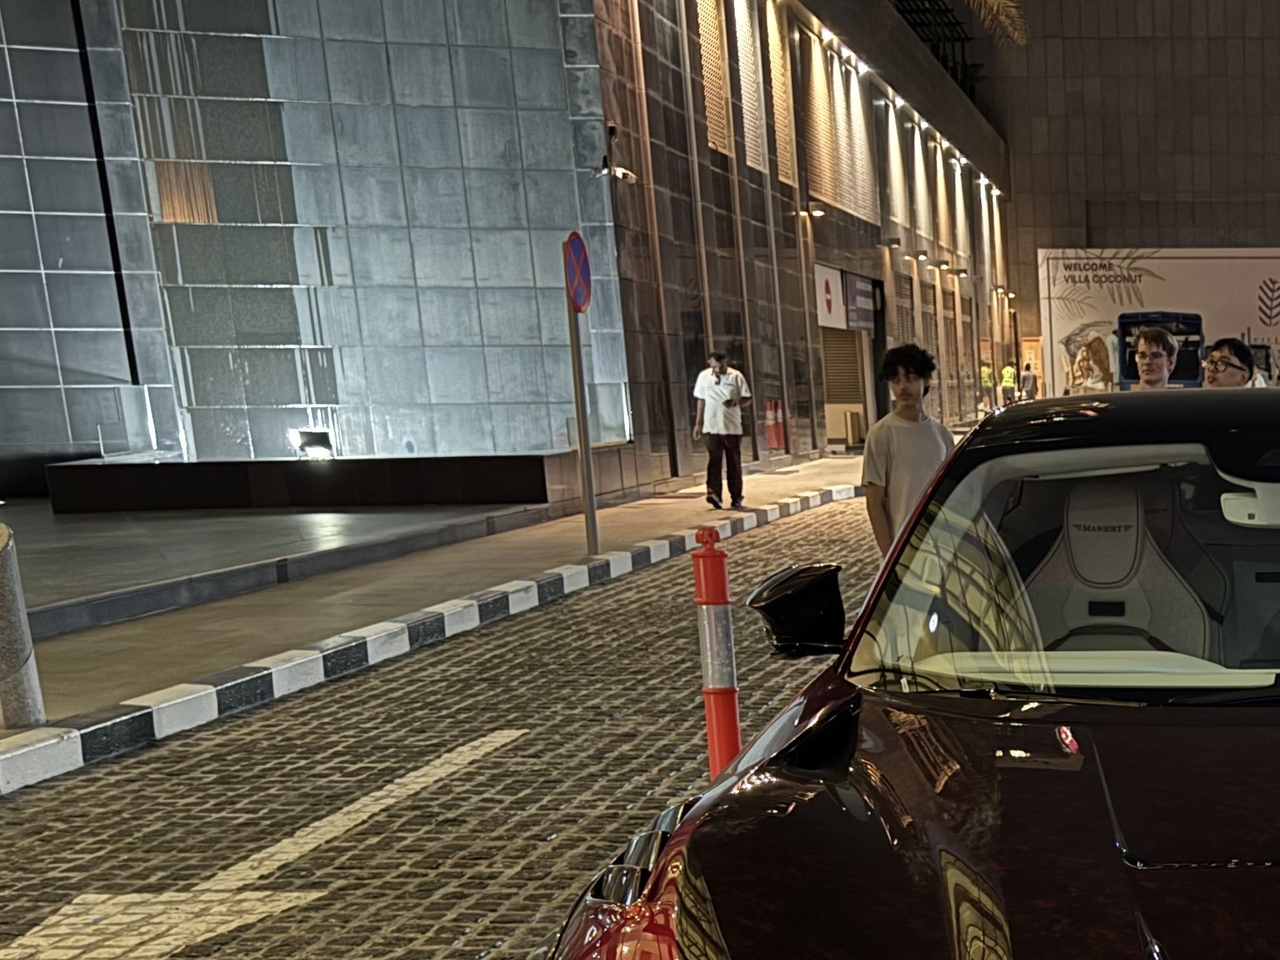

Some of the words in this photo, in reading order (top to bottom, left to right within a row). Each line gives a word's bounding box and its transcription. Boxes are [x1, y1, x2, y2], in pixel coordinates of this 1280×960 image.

[1063, 262, 1114, 272] WELCOME
[1063, 274, 1090, 284] VILLA
[1092, 274, 1143, 284] COCONUT
[1082, 524, 1124, 533] MANSORY
